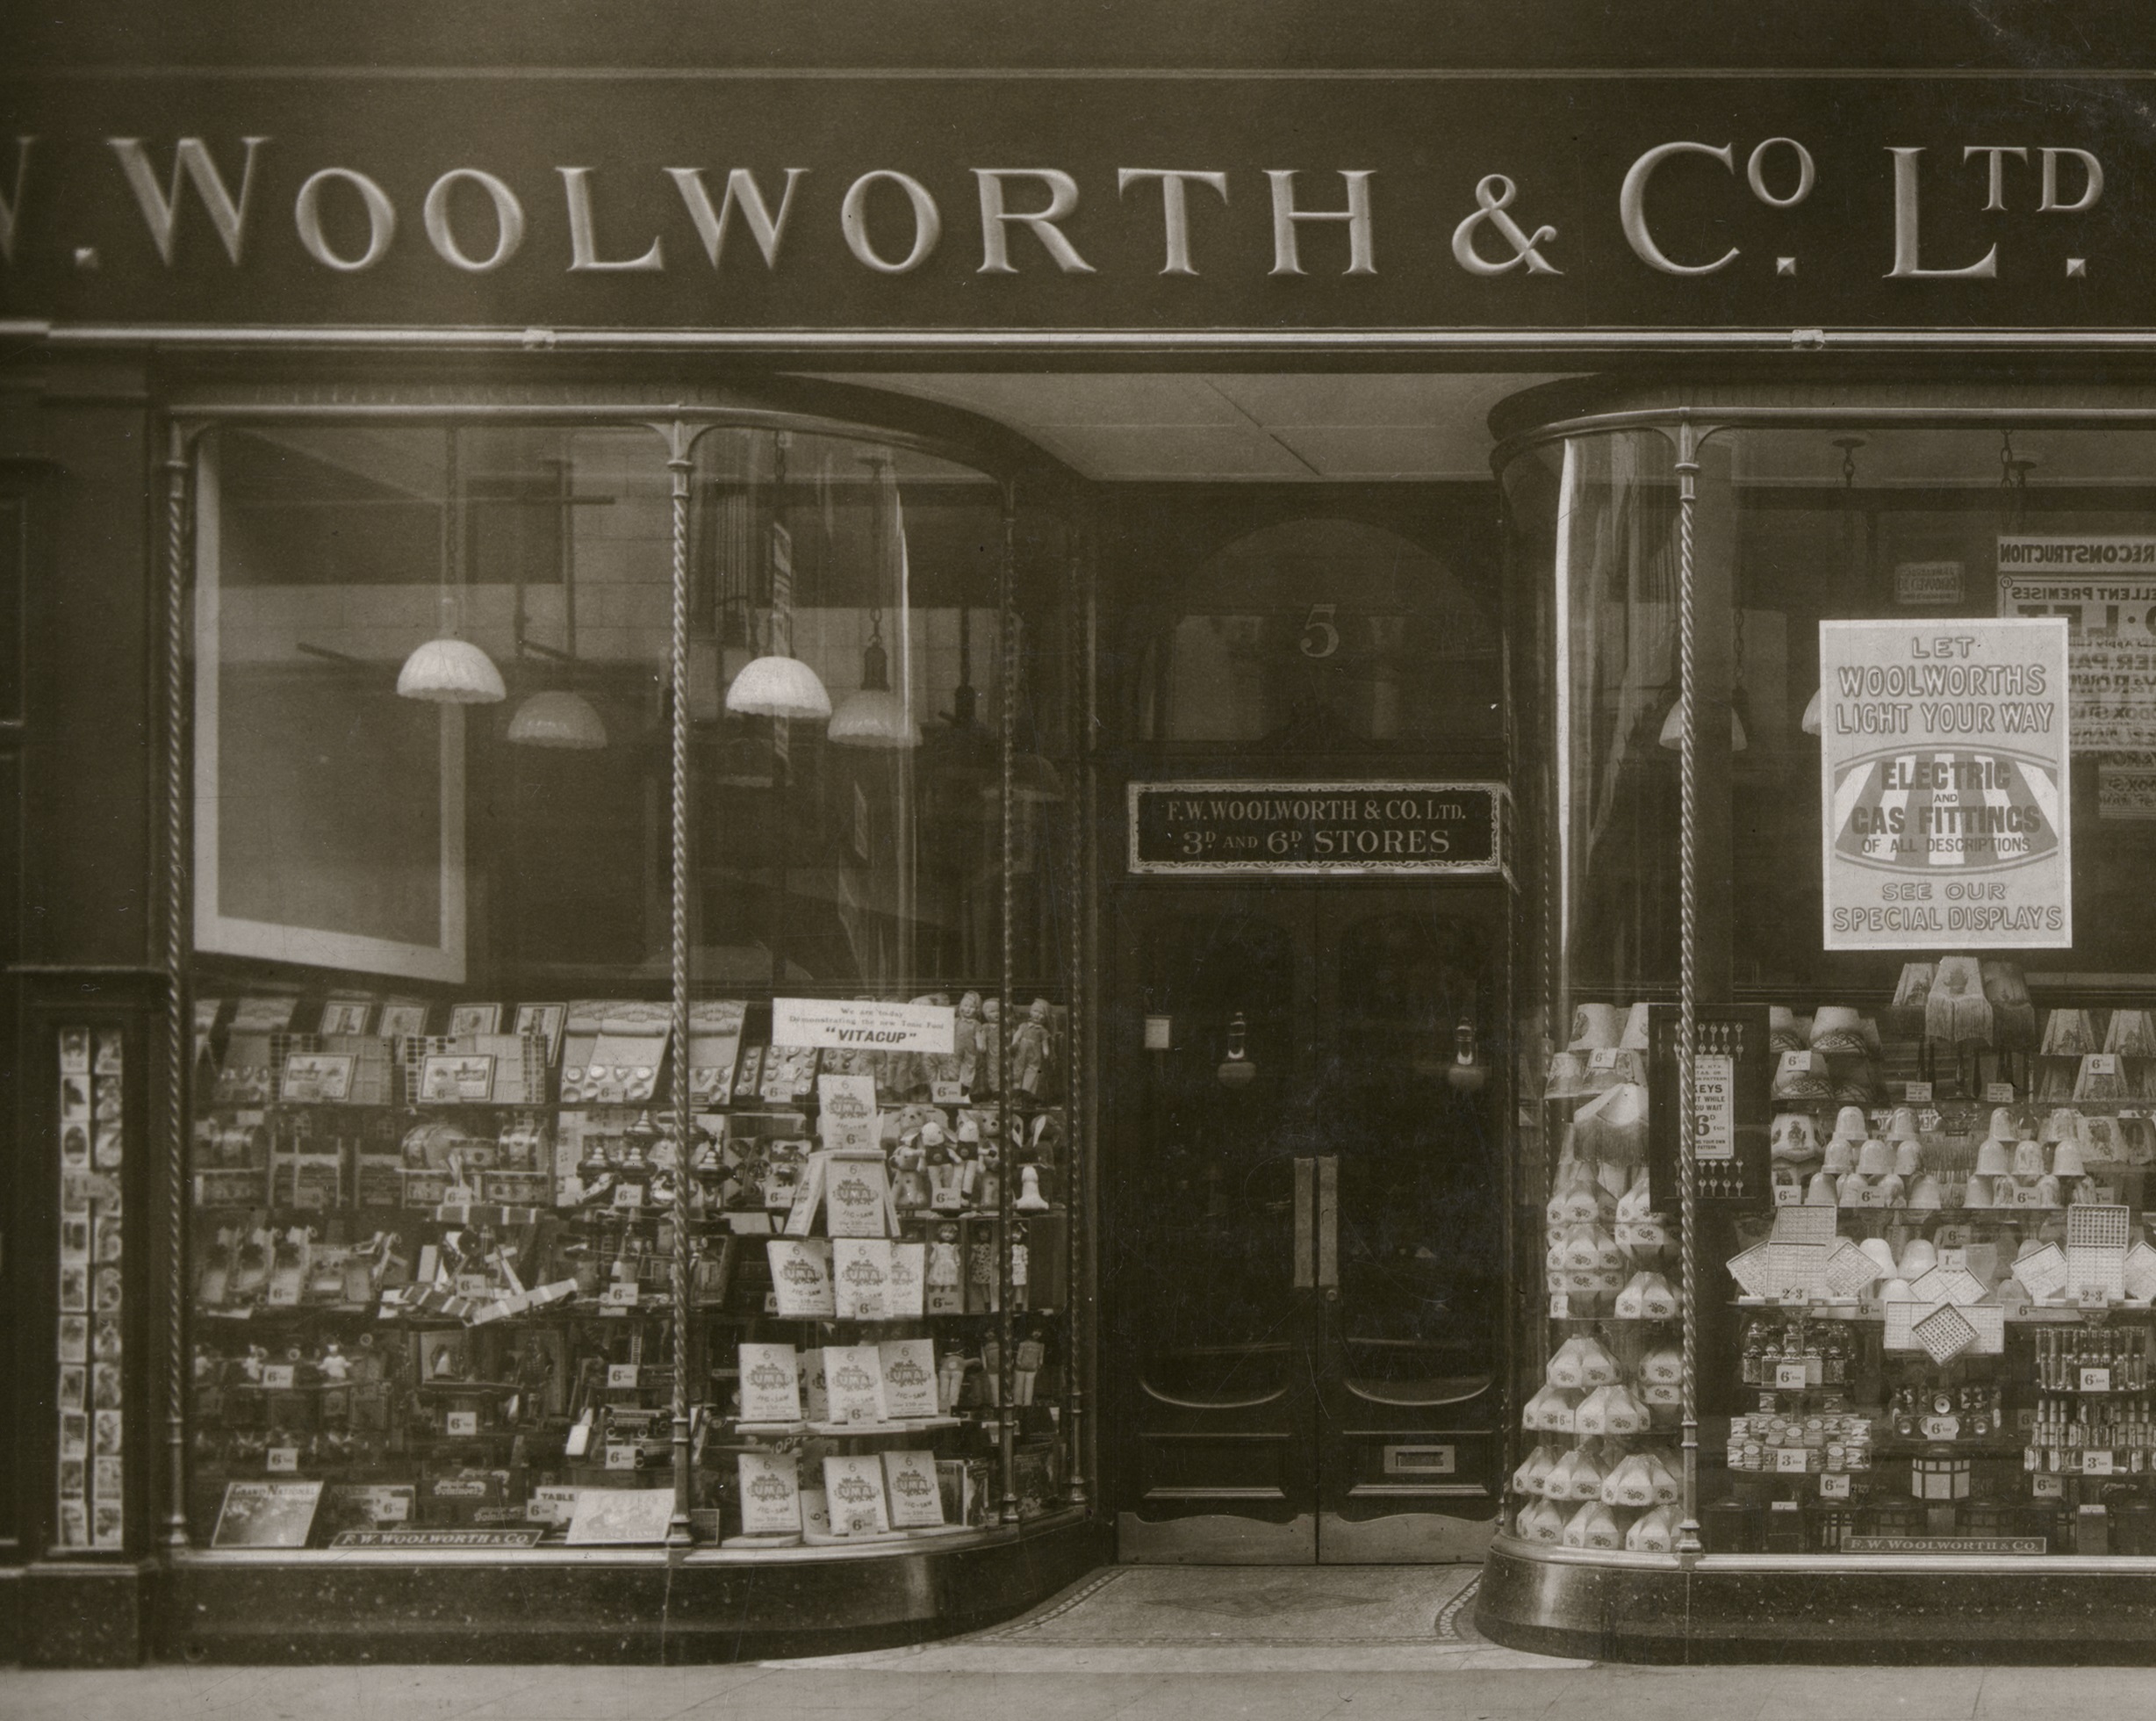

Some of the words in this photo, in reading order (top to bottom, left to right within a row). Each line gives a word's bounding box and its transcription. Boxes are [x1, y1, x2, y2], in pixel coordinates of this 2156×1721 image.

[107, 136, 1378, 275] WOOLWORTH
[1452, 174, 1563, 274] &
[1299, 604, 1340, 658] 5
[1912, 637, 1975, 659] LET
[1838, 664, 2046, 697] WOOLWORTHS
[1836, 702, 1912, 734] LIGHT
[1920, 702, 1995, 733] YOUR
[2000, 702, 2053, 733] WAY
[1880, 761, 2011, 790] ELECTRIC
[1933, 793, 1958, 803] AND
[1364, 800, 1380, 821] &
[1385, 800, 1421, 821] CO.
[1851, 806, 1905, 835] GAS
[1918, 805, 2041, 834] FITTINGS
[1223, 837, 1258, 849] AND
[1314, 829, 1450, 854] STORES
[1862, 838, 1879, 853] OF
[1890, 838, 1917, 853] ALL
[1927, 837, 2031, 853] DESCRIPTIONS
[1882, 882, 1932, 901] SEE
[1945, 882, 2006, 900] OUR
[1833, 907, 1943, 931] SPECIAL
[1948, 905, 2063, 931] DISPLAYS
[789, 1015, 856, 1026] Demonstrating
[1788, 1055, 1796, 1066] 6
[2091, 1059, 2100, 1069] 6
[938, 1087, 946, 1097] 6
[936, 1193, 945, 1203] 6
[1779, 1191, 1787, 1200] 6
[1861, 1192, 1871, 1201] 6
[2017, 1192, 2025, 1203] 6
[859, 1303, 868, 1314] 6
[933, 1298, 942, 1308] 6
[902, 1347, 909, 1357] 6
[613, 1370, 622, 1380] 6
[1780, 1371, 1790, 1383] 6
[2085, 1374, 2094, 1385] 6
[852, 1408, 860, 1419] 6
[451, 1418, 461, 1429] 6
[1931, 1423, 1940, 1434] 6
[610, 1451, 620, 1462] 6
[905, 1457, 913, 1466] 6
[1782, 1455, 1791, 1466] 3
[764, 1460, 771, 1471] 6
[2088, 1458, 2096, 1468] 3
[1824, 1479, 1834, 1491] 6
[2037, 1480, 2046, 1490] 6
[541, 1493, 575, 1501] TABLE
[531, 1505, 539, 1516] 6
[852, 1519, 862, 1531] 6
[2000, 1540, 2009, 1550] &
